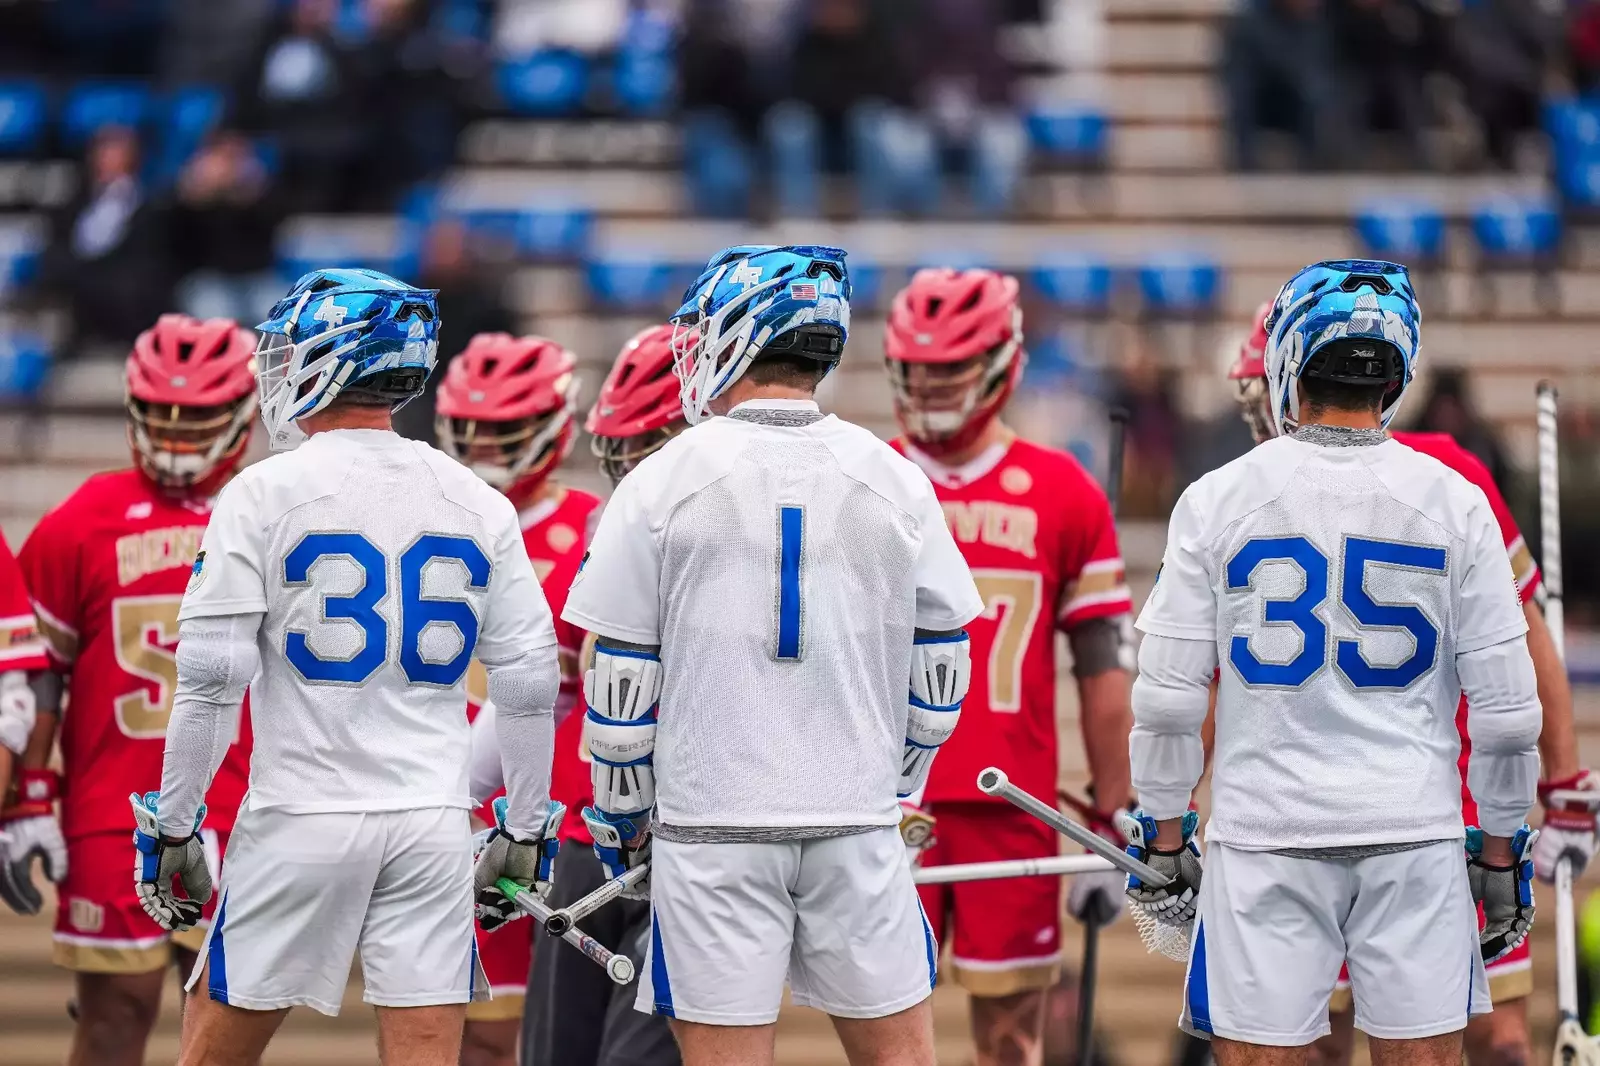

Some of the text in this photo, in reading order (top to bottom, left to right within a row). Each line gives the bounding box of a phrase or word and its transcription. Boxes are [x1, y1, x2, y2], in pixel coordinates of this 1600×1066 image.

[115, 525, 208, 587] DEN
[772, 503, 807, 663] 1
[940, 500, 1038, 559] VER
[112, 594, 186, 740] 5
[282, 529, 494, 690] 36
[966, 568, 1043, 713] 7
[1223, 533, 1450, 693] 35
